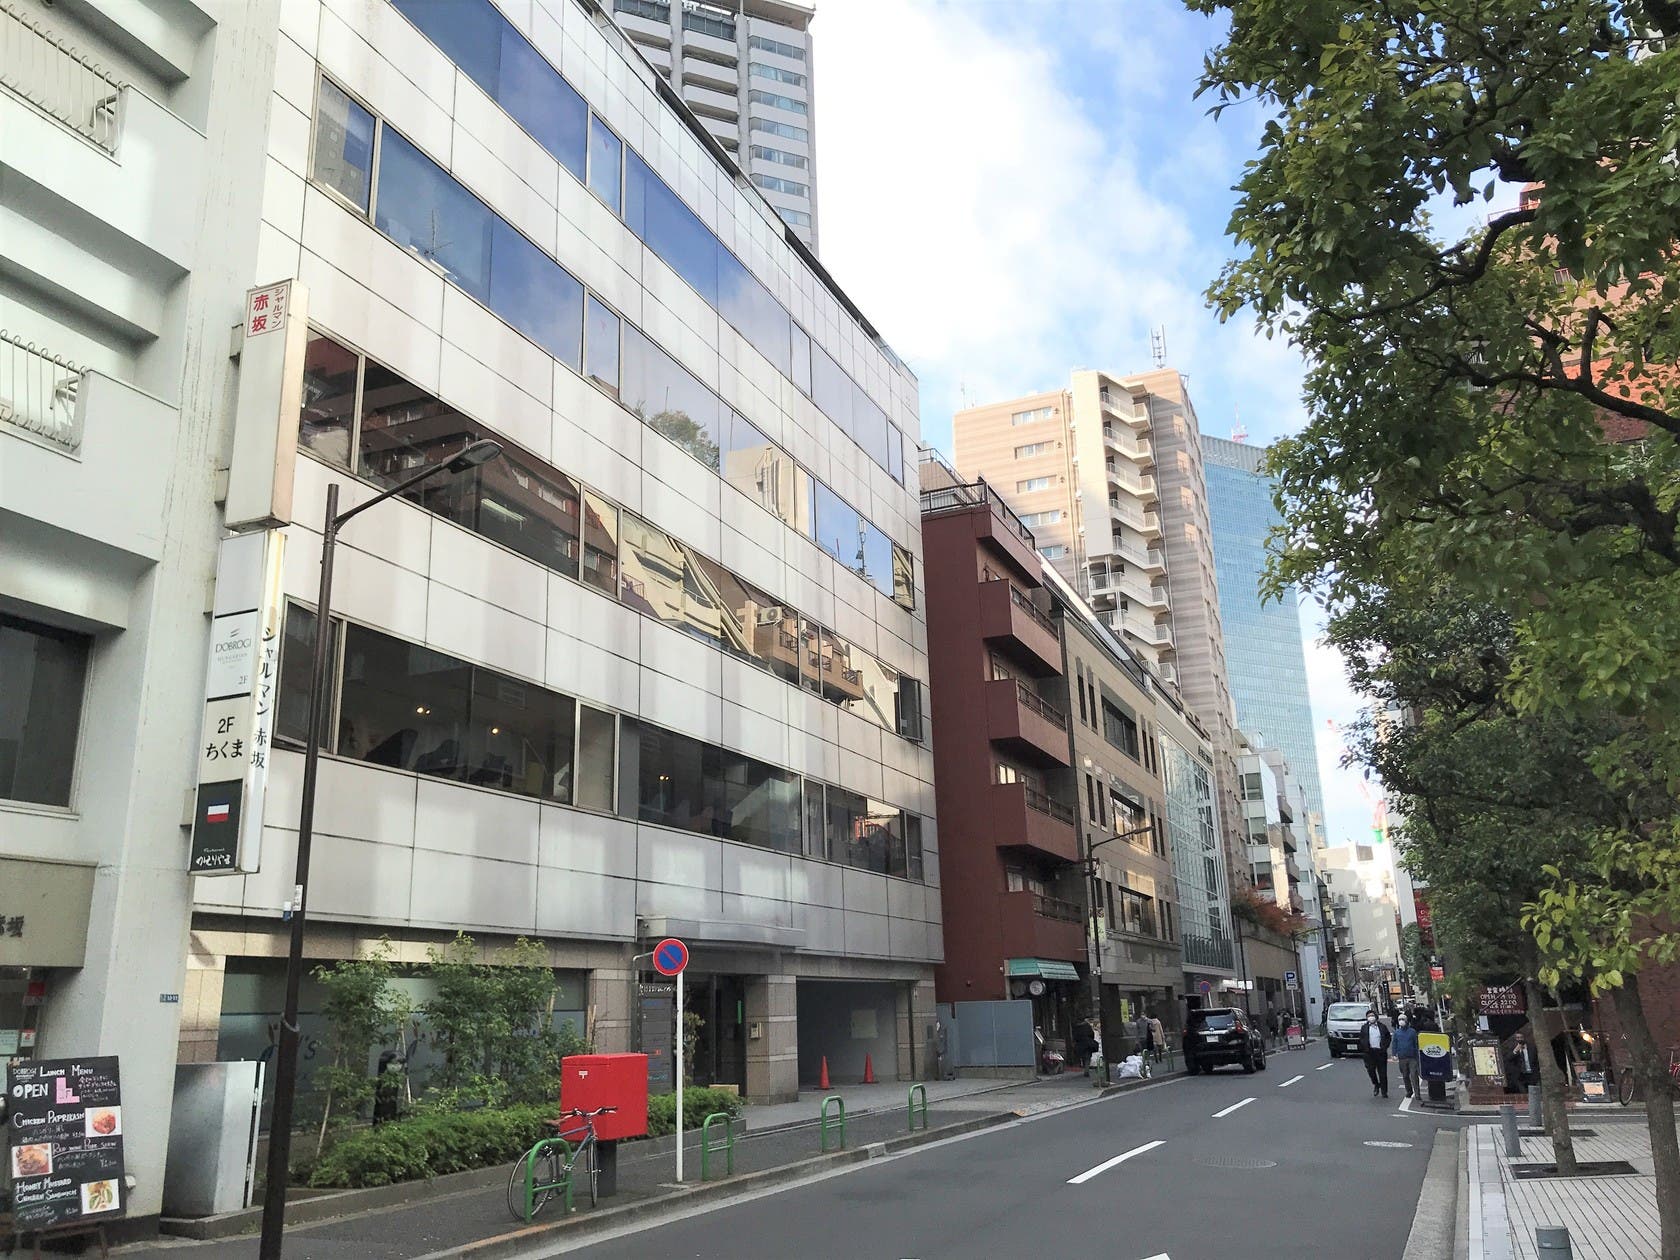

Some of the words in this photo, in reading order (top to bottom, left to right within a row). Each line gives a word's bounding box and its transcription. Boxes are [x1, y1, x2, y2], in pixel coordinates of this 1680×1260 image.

[252, 294, 269, 332] 赤坂
[272, 288, 284, 328] シャルマン
[238, 675, 248, 685] 2F
[217, 716, 235, 733] 2F
[206, 738, 243, 761] ちくま
[1286, 972, 1295, 982] P
[40, 1066, 65, 1077] LUNCH
[71, 1064, 93, 1076] MENU
[13, 1083, 49, 1099] OPEN
[14, 1112, 46, 1128] CHICKEN
[16, 1181, 42, 1194] HONEY
[43, 1177, 72, 1190] MUSTARD
[15, 1193, 45, 1203] CHICKEN
